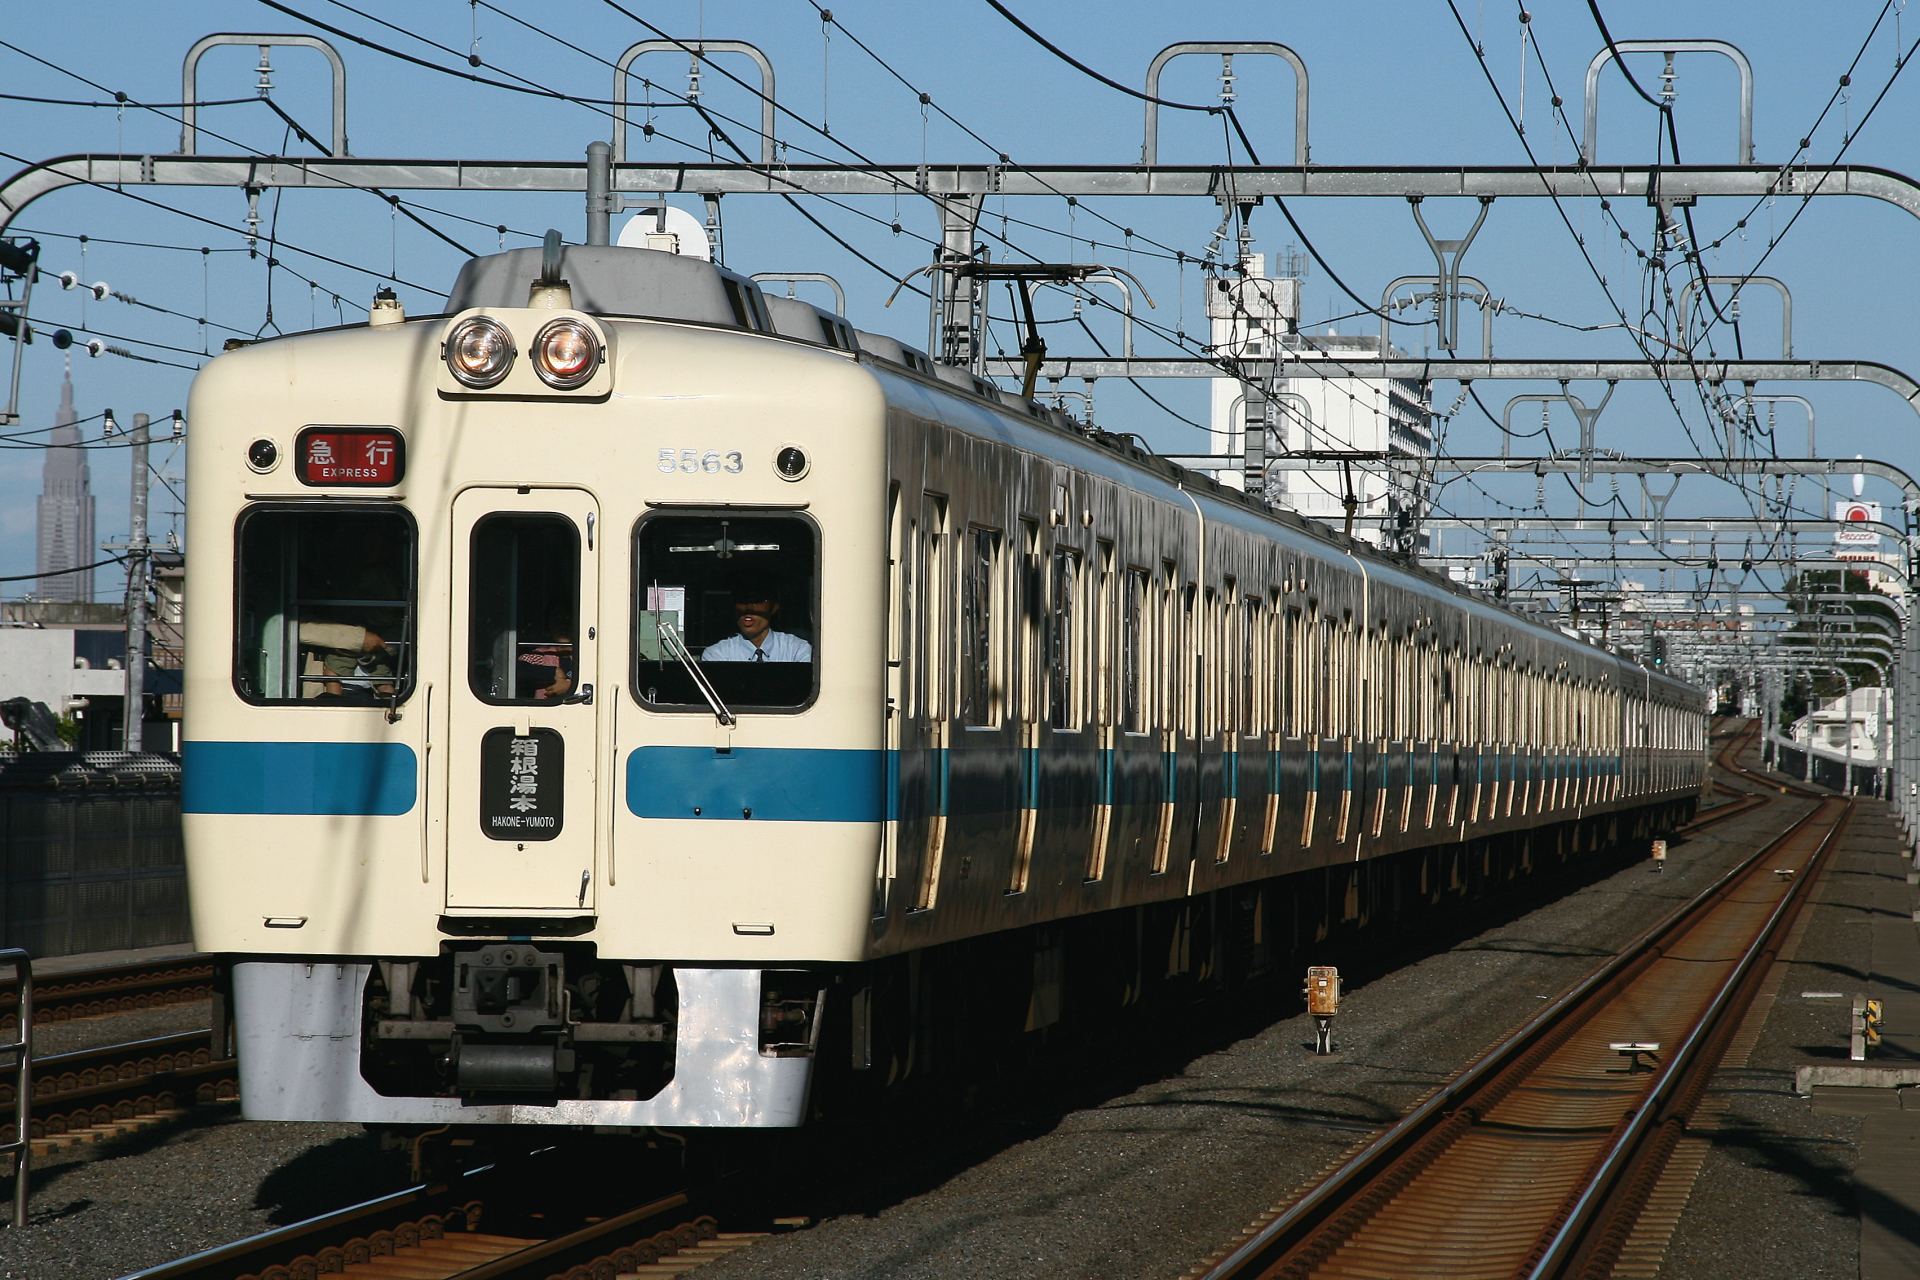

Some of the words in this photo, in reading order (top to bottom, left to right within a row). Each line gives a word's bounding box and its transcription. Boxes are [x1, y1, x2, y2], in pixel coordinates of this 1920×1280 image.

[308, 439, 394, 466] 急行
[657, 448, 744, 474] 5563
[322, 468, 378, 478] EXPRESS
[509, 738, 539, 813] 箱根湯本
[491, 816, 555, 828] HAKONE-YUMOTO
